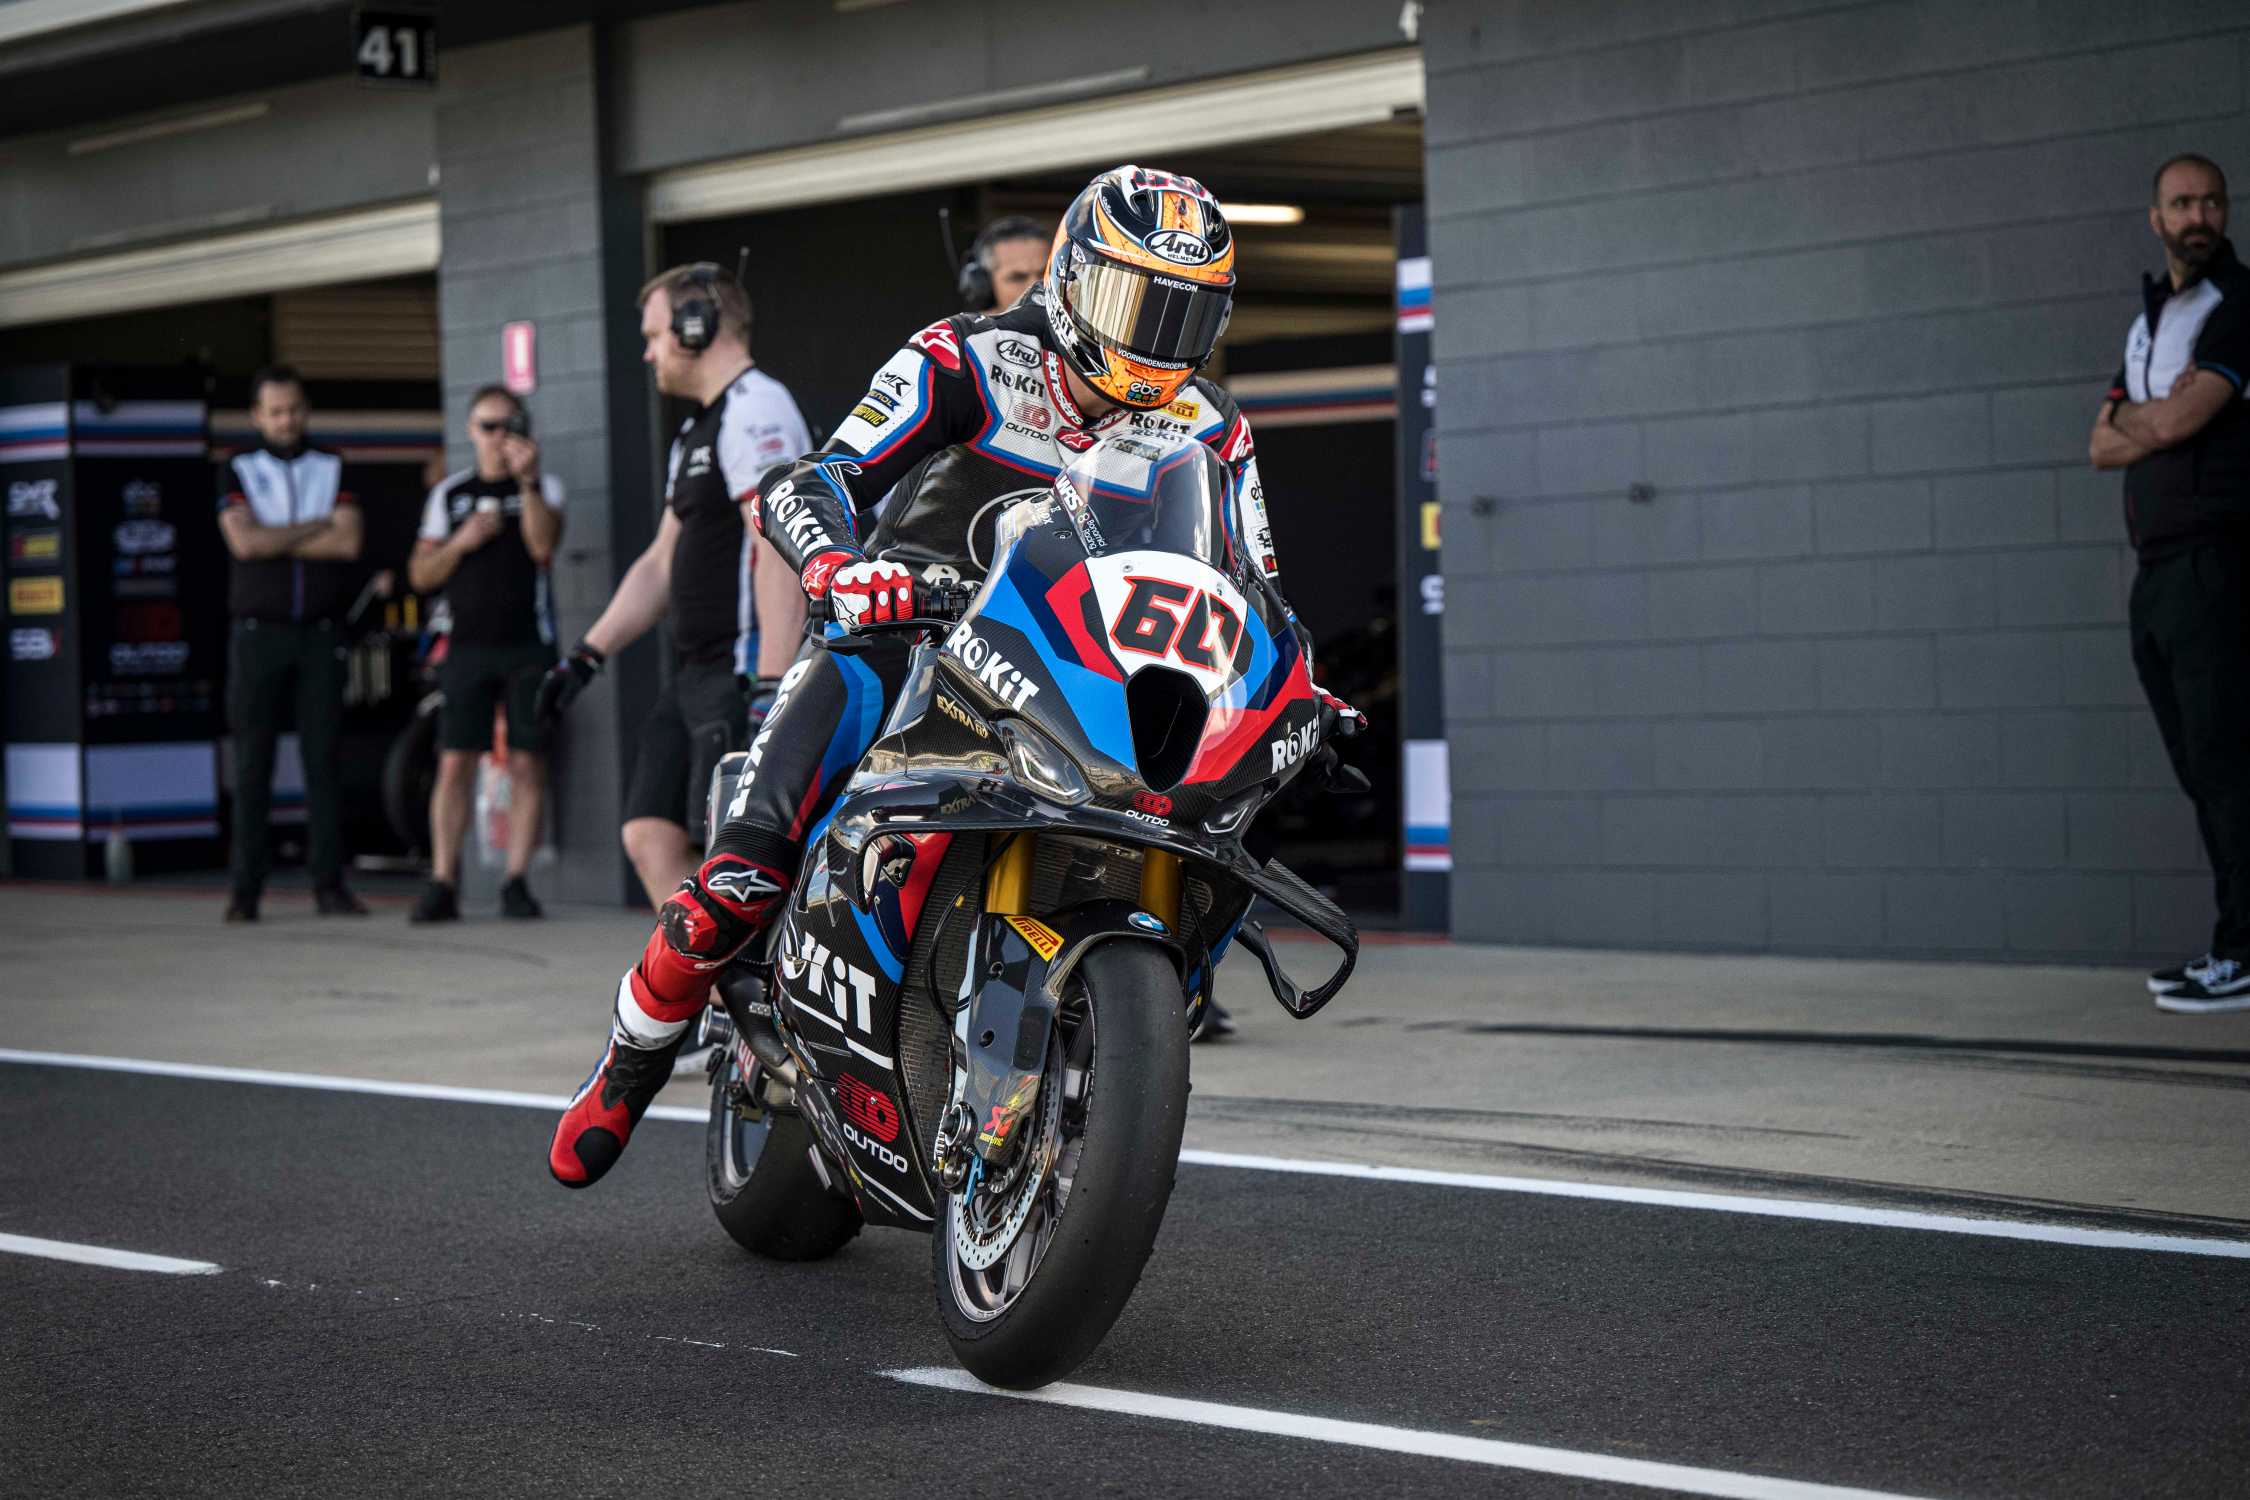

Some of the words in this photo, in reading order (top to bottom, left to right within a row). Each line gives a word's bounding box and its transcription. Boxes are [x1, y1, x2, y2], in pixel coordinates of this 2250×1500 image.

[358, 25, 418, 77] 41
[1150, 233, 1206, 259] Arai
[1153, 275, 1199, 294] HAVECON
[1000, 341, 1038, 364] Arai
[990, 364, 1045, 398] ROKiT
[1130, 380, 1162, 396] ebc
[1005, 422, 1050, 442] OUTDO
[1055, 474, 1084, 512] WRS
[1250, 481, 1264, 501] eb
[766, 480, 834, 557] ROKiT
[1082, 528, 1097, 550] Racing
[1109, 576, 1243, 677] 60
[946, 620, 1040, 712] ROKiT
[1271, 713, 1320, 775] ROKi
[1125, 809, 1170, 827] OUTDO
[1011, 916, 1059, 955] PIRELLI
[843, 1122, 908, 1173] OUTDO
